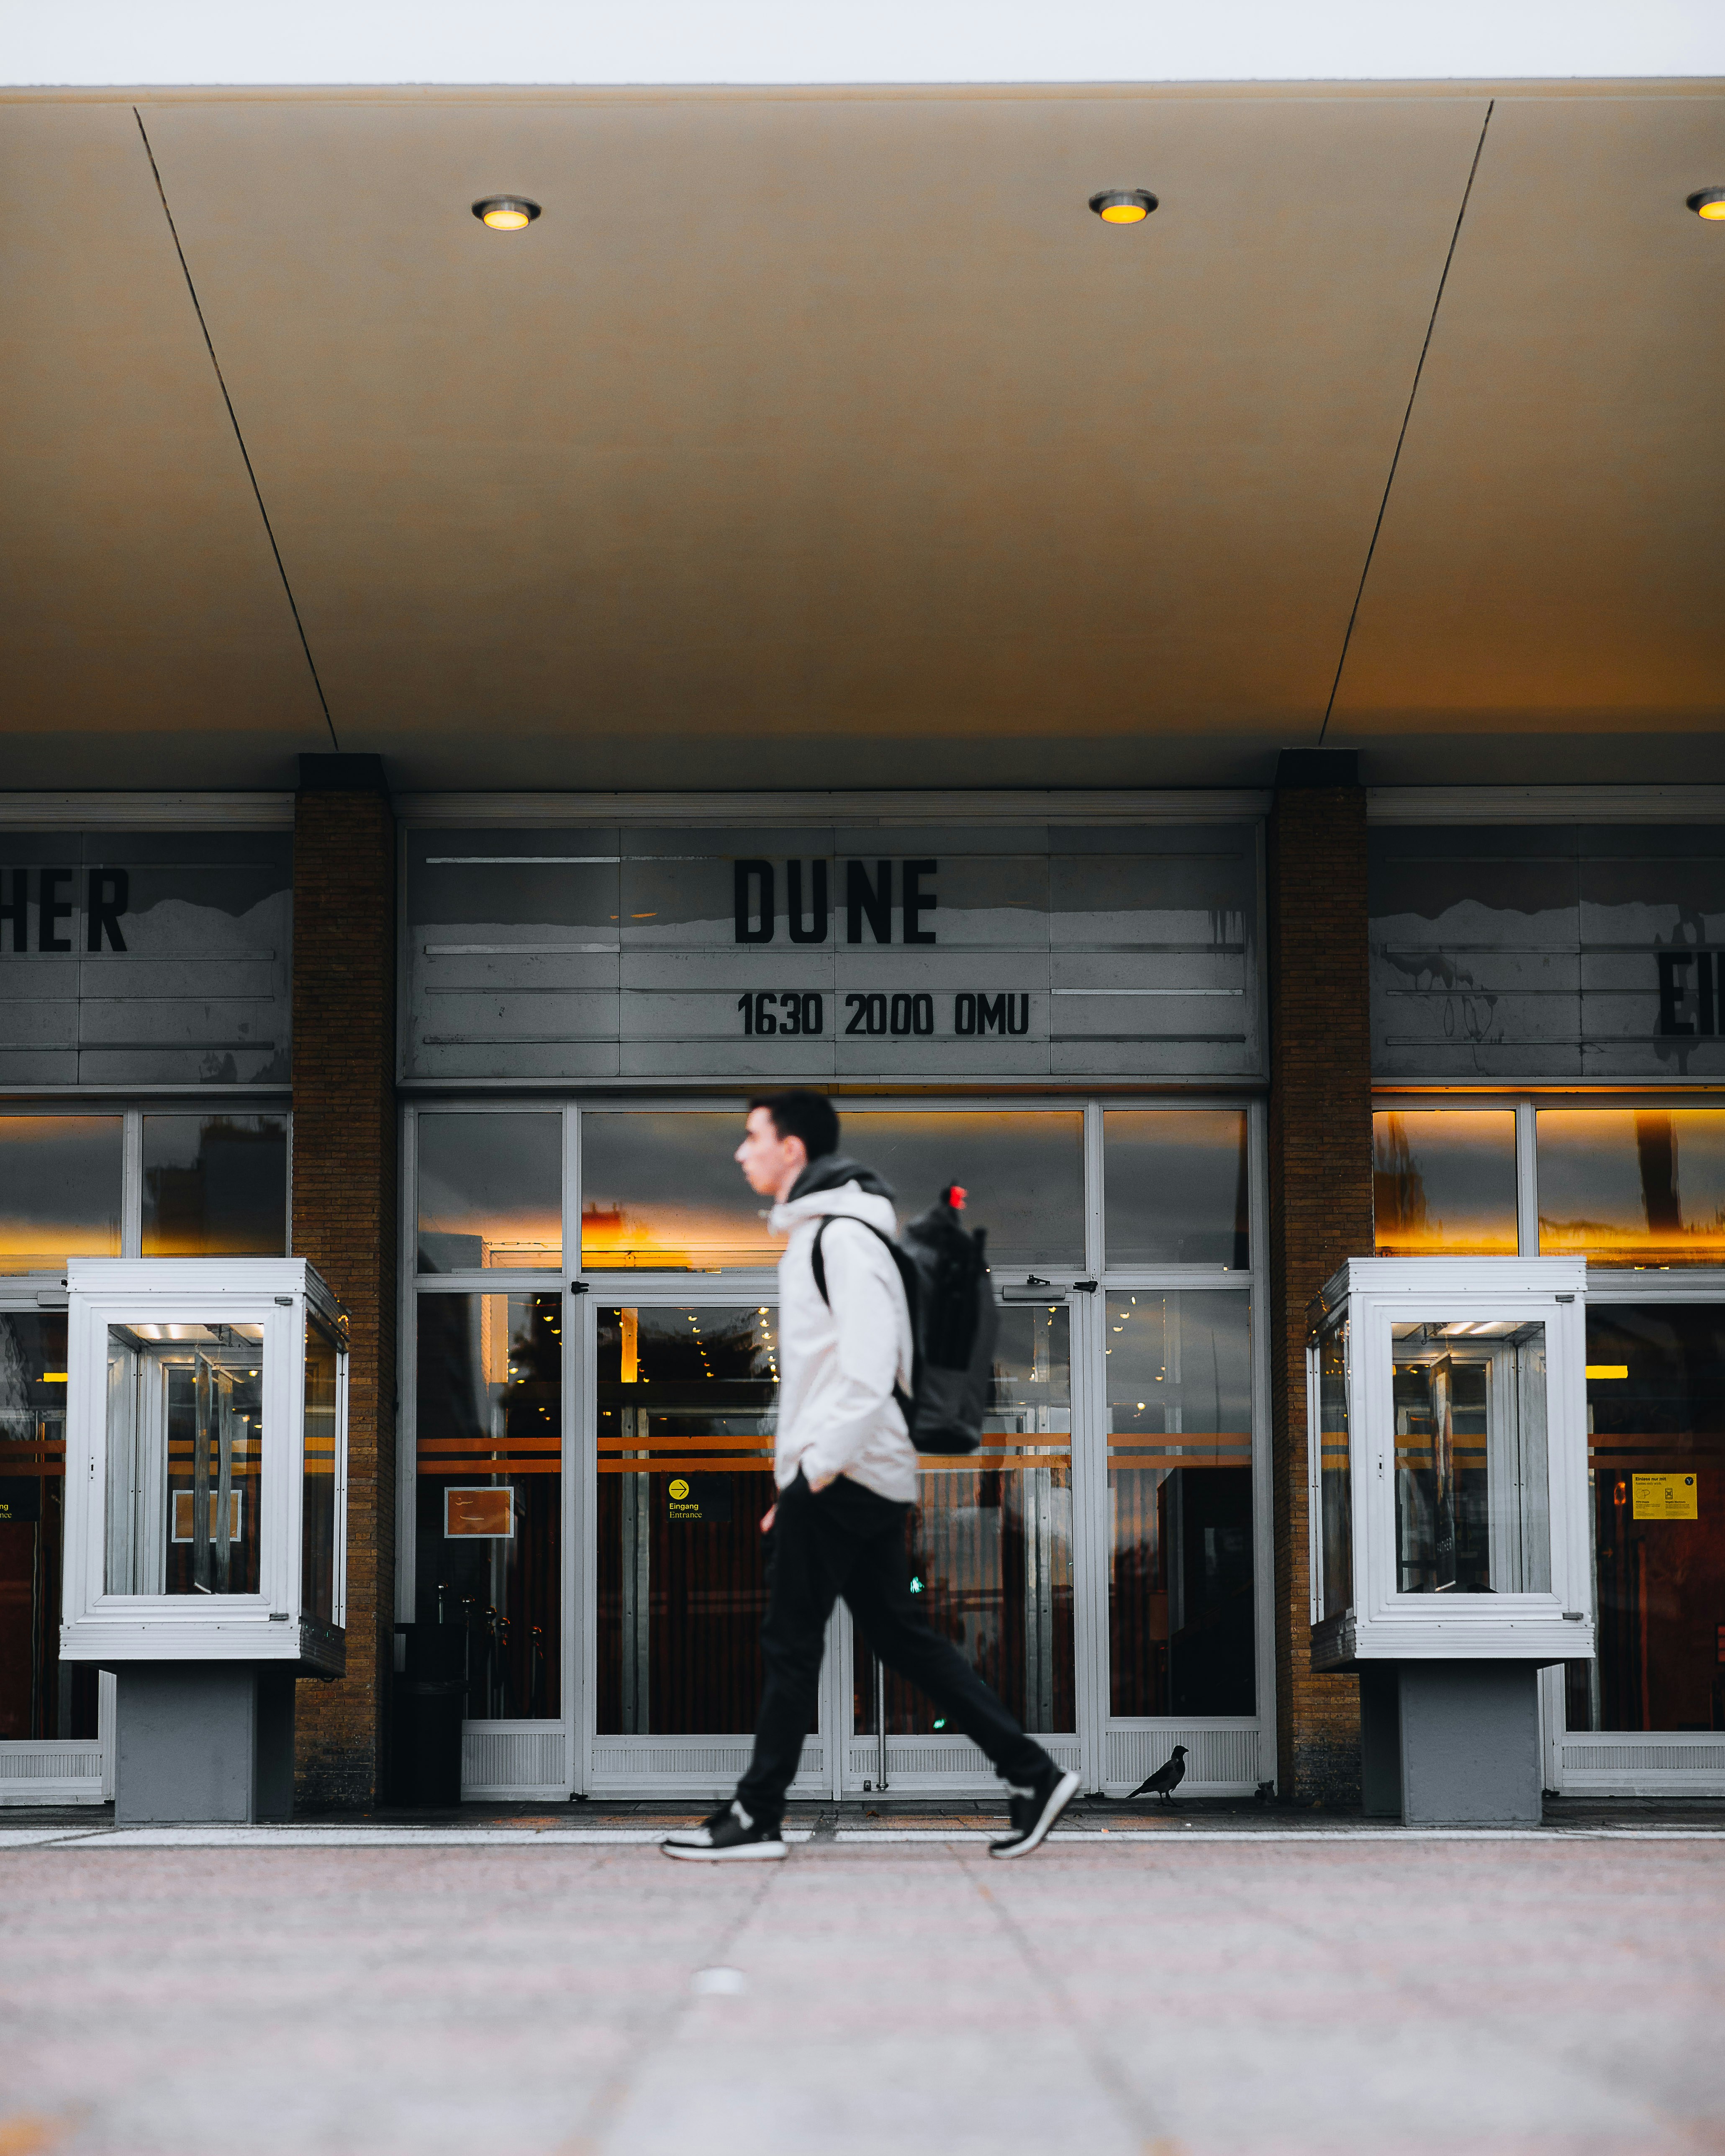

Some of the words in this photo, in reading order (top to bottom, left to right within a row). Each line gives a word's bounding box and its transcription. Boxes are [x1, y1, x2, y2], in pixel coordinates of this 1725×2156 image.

[734, 859, 937, 944] DUNE
[737, 993, 823, 1035] 1630
[845, 993, 934, 1035] 2000
[955, 993, 1029, 1035] OMU
